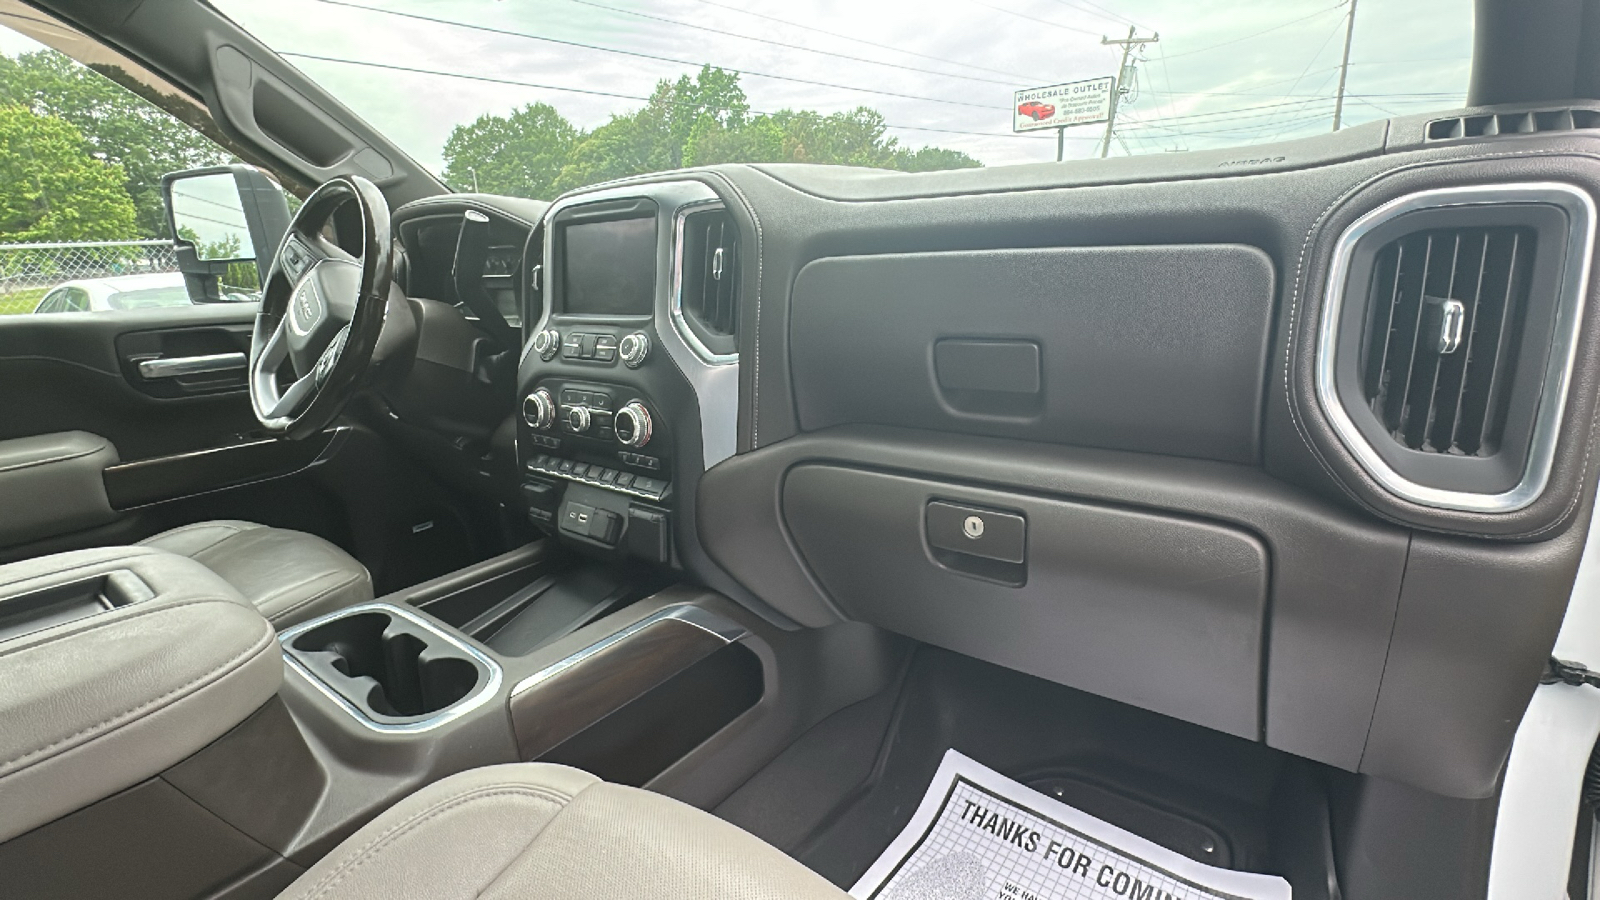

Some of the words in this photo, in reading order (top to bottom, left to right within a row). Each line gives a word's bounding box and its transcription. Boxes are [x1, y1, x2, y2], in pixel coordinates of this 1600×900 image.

[1018, 88, 1069, 102] WHOLESALE
[1073, 82, 1109, 94] OUTLET
[1218, 156, 1286, 168] AIRBAG
[961, 799, 1041, 853] THANKS
[1043, 839, 1092, 878] FOR
[1004, 882, 1021, 895] WE
[998, 891, 1017, 900] YO
